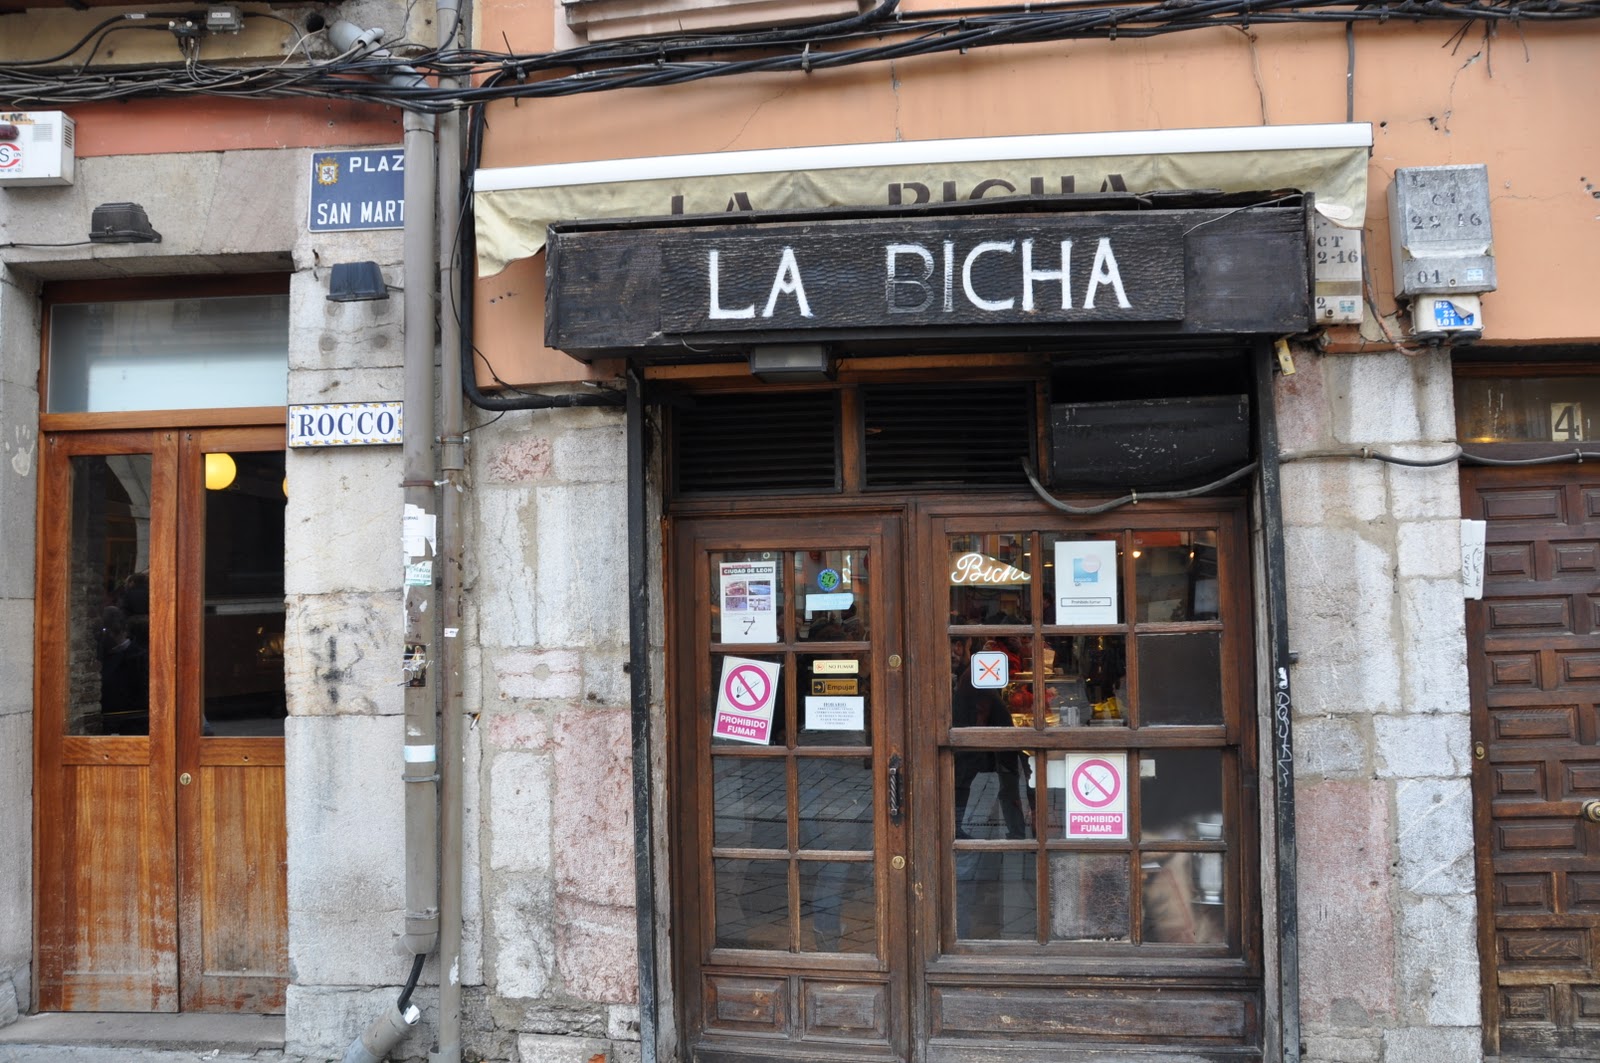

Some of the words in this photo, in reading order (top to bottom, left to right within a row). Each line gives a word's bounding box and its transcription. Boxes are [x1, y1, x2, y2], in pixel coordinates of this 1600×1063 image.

[317, 202, 351, 225] SAN
[1317, 235, 1344, 248] CT
[708, 246, 814, 320] LA
[885, 236, 1133, 314] BICHA
[1417, 270, 1442, 284] 01
[298, 411, 394, 437] ROCCO
[1555, 405, 1580, 441] 4
[720, 715, 766, 728] PROHIBIDO
[727, 726, 756, 737] FUMAR
[1071, 815, 1121, 823] PROHIBIDO
